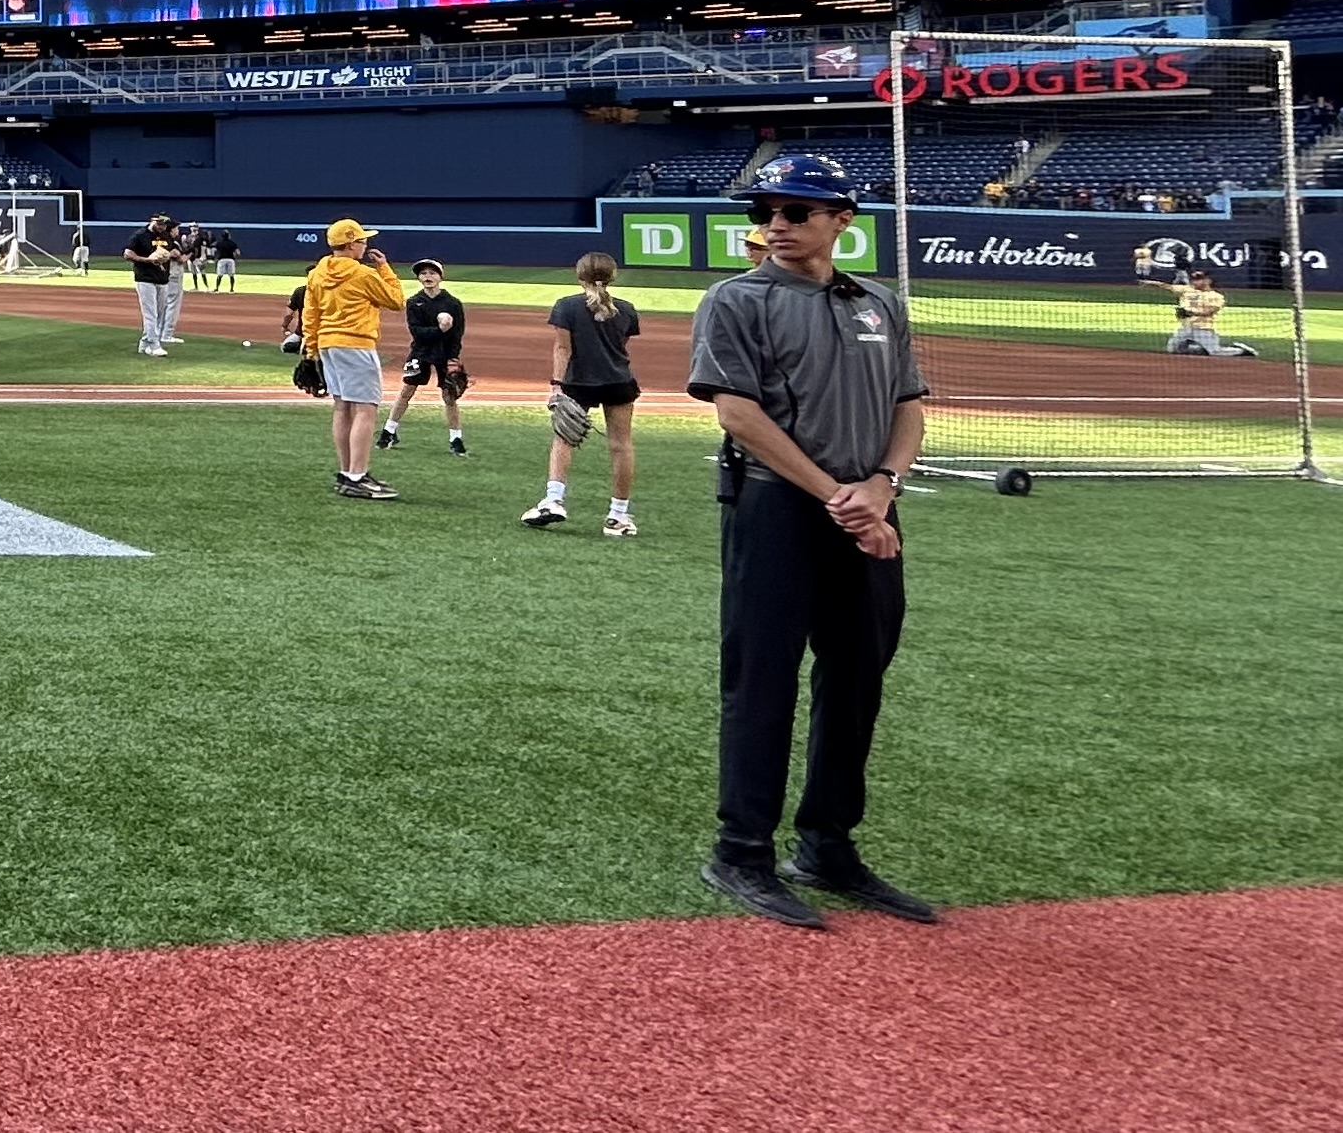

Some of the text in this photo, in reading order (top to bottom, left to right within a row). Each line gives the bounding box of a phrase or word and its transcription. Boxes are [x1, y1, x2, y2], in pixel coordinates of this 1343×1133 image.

[226, 66, 412, 90] WESTJET FLIGHT
[370, 77, 406, 87] DECK
[942, 54, 1189, 98] ROGERS
[296, 233, 318, 243] 400
[630, 223, 684, 255] TD
[918, 236, 1097, 267] Tim Hortons
